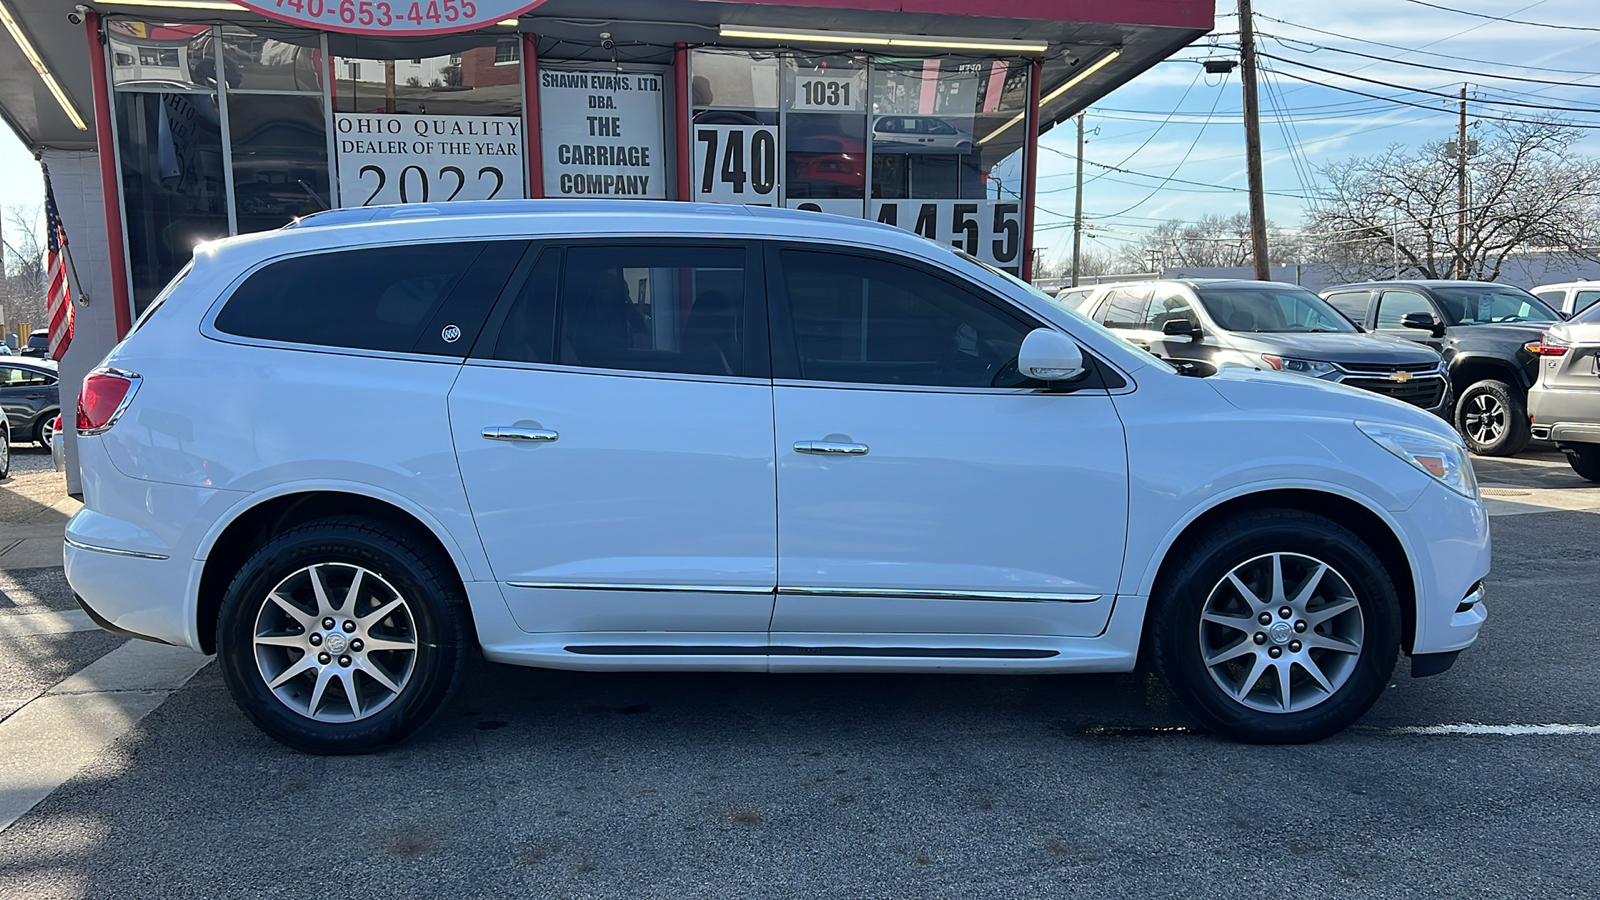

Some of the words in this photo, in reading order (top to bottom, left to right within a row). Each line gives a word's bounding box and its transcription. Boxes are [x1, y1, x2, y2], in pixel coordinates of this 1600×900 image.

[542, 73, 588, 89] SHAWN
[637, 77, 661, 92] LTD.
[588, 95, 617, 109] DBA.
[802, 81, 850, 106] 1031
[337, 118, 401, 134] OHIO
[414, 119, 519, 137] QUALITY
[586, 116, 621, 137] THE
[341, 140, 408, 154] DEALER
[412, 141, 434, 154] OF
[438, 142, 472, 155] THE
[475, 142, 518, 156] YEAR
[558, 144, 650, 167] CARRIAGE
[697, 129, 775, 195] 740
[359, 164, 504, 207] 2022
[560, 173, 650, 195] COMPANY
